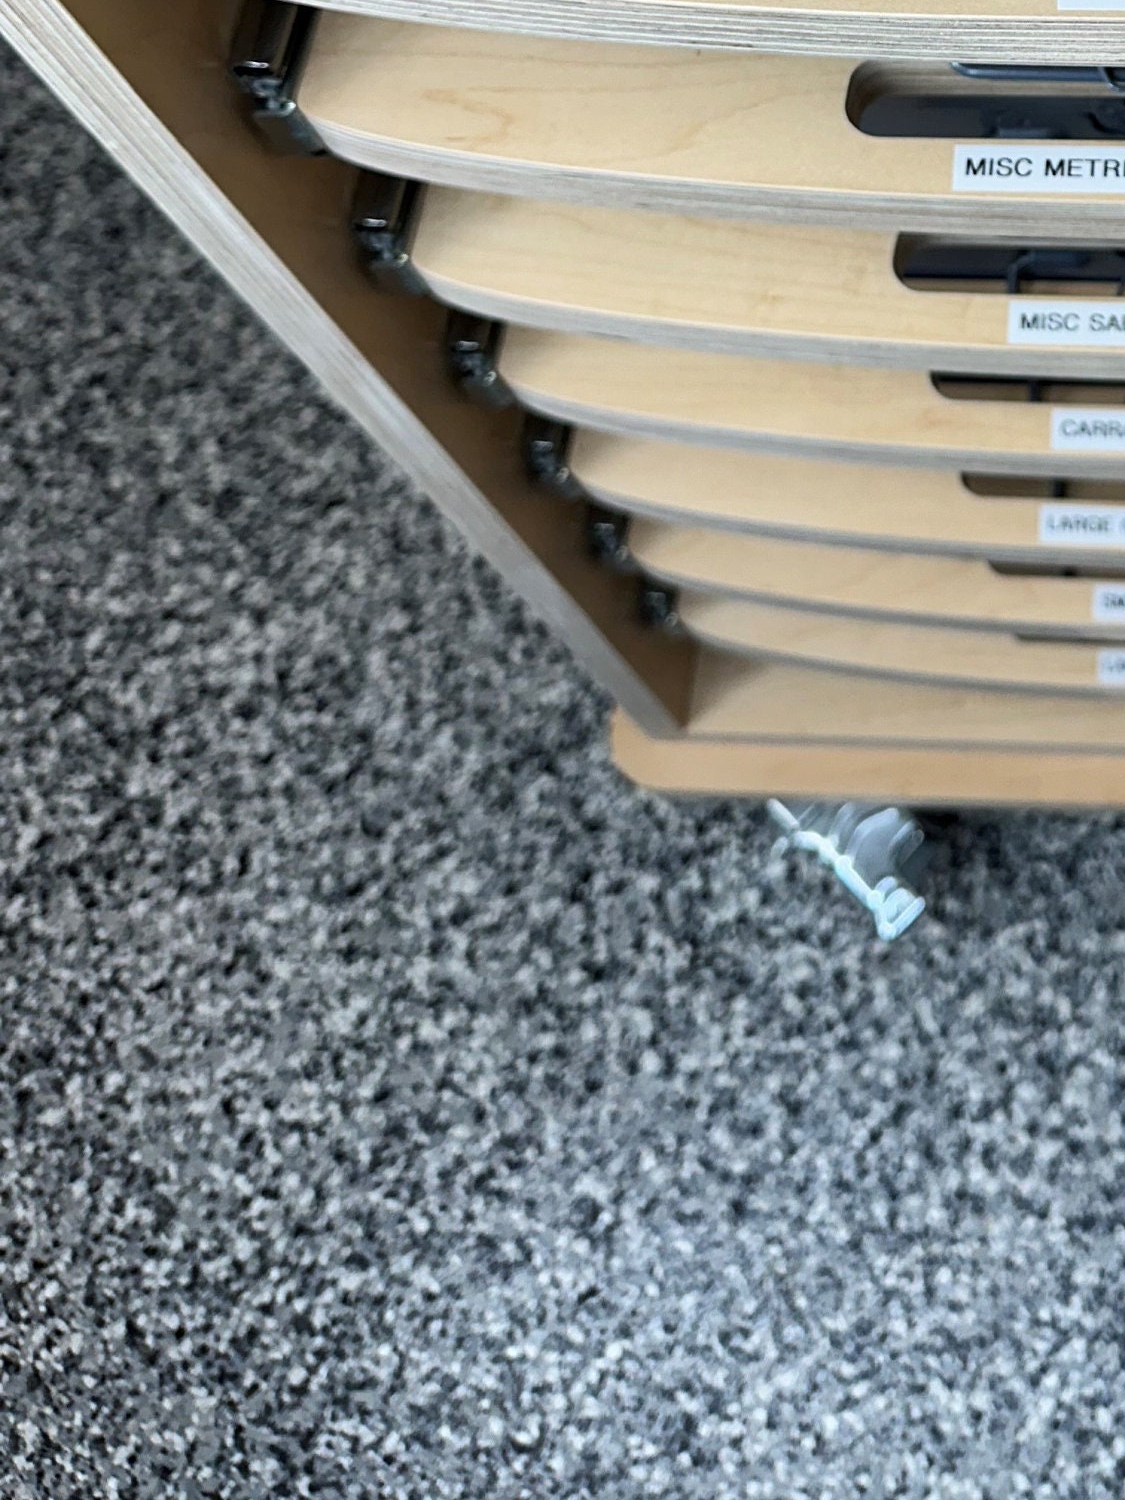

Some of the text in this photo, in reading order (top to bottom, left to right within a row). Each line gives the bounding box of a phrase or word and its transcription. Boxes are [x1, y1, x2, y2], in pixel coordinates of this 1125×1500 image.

[964, 156, 1034, 178] MISC
[1018, 312, 1081, 333] MISC
[1046, 513, 1112, 534] LARGE
